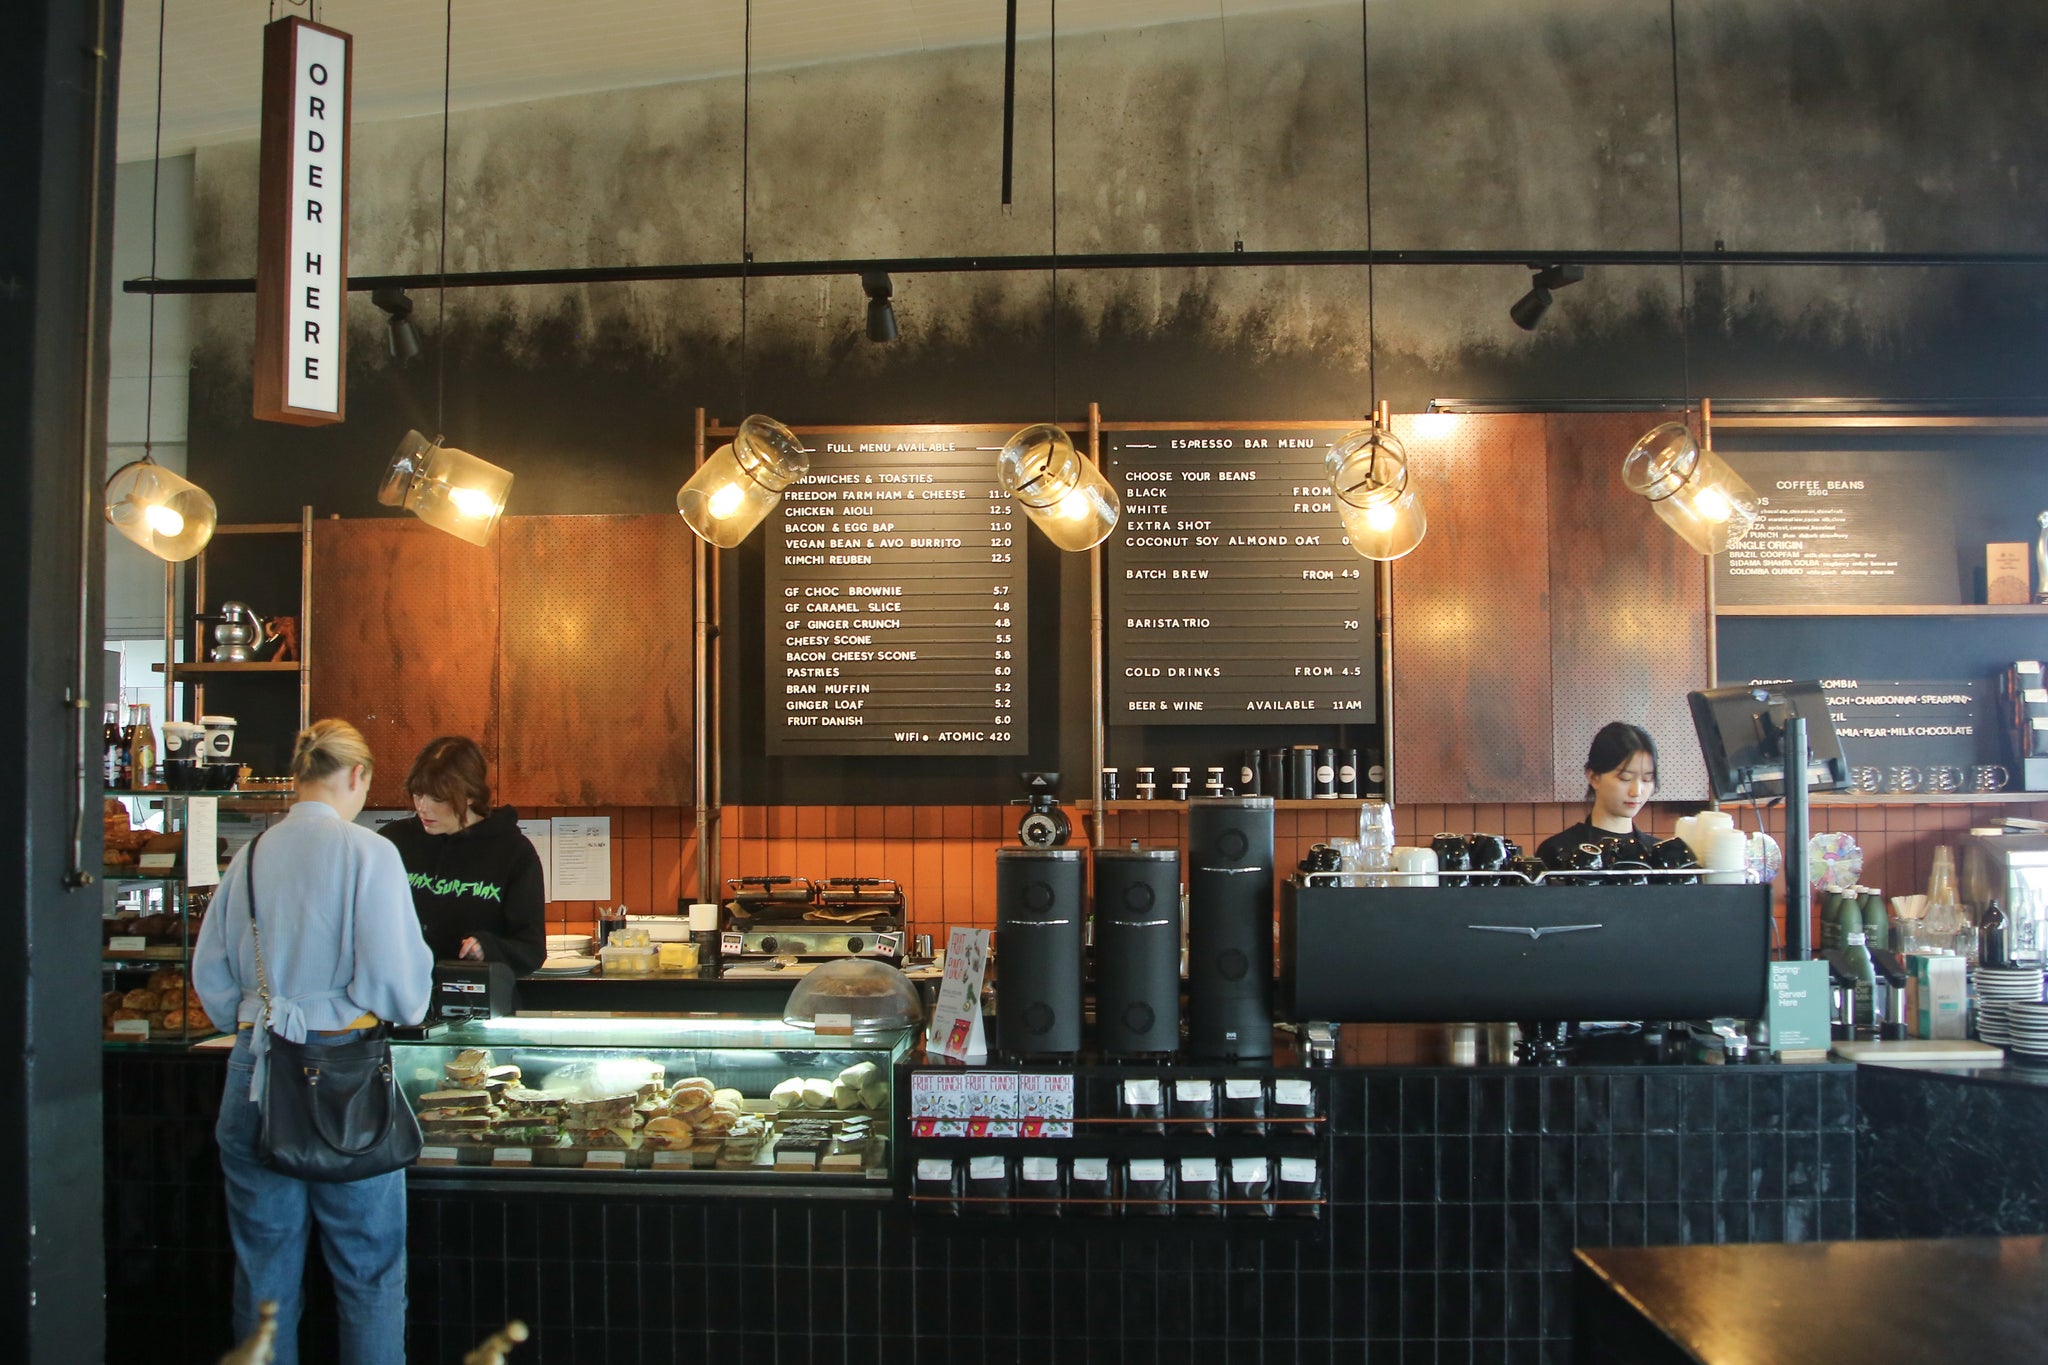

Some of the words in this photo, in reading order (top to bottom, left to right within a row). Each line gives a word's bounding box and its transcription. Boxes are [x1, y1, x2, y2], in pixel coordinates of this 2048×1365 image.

[307, 62, 329, 224] ORDER
[304, 251, 322, 381] HERE
[828, 444, 853, 452] FULL
[860, 444, 891, 452] MENU
[897, 443, 955, 451] AVAILABLE
[1172, 440, 1232, 448] ESPRESSO
[1245, 439, 1267, 448] BAR
[1279, 439, 1313, 447] MENU
[792, 473, 860, 484] NDWICHES
[865, 475, 872, 483] &
[879, 474, 933, 482] TOASTIES
[1126, 472, 1172, 480] CHOOSE
[1182, 472, 1210, 481] YOUR
[1219, 471, 1255, 480] BEANS
[1777, 481, 1819, 489] COFFEE
[1828, 481, 1864, 489] BEANS
[785, 492, 836, 500] FREEDOM
[877, 491, 901, 499] HAM
[907, 490, 914, 498] &
[922, 490, 965, 499] CHEESE
[1128, 488, 1166, 497] BLACK
[1294, 487, 1331, 495] FROM
[786, 507, 833, 516] CHICKEN
[843, 507, 872, 515] AIOLI
[991, 506, 1011, 514] 12.5
[1127, 505, 1167, 513] WHITE
[1295, 503, 1331, 512] FROM
[786, 524, 824, 532] BACON
[832, 524, 839, 532] &
[845, 523, 867, 532] EGG
[873, 523, 894, 532] BAP
[1128, 522, 1170, 530] EXTRA
[1178, 521, 1211, 530] SHOT
[786, 540, 824, 548] VEGAN
[830, 539, 860, 547] BEAN
[867, 539, 874, 547] &
[880, 539, 903, 547] AVO
[911, 539, 961, 547] BURRITO
[992, 538, 1011, 546] 12.0
[1126, 538, 1188, 546] COCONUT
[1196, 537, 1218, 545] SOY
[1229, 536, 1287, 545] ALMOND
[1296, 536, 1319, 545] OAT
[1767, 541, 1803, 550] ORIGIN
[785, 556, 824, 564] KIMCHI
[830, 556, 871, 564] REUBEN
[992, 554, 1010, 562] 12.5
[1127, 570, 1166, 578] BATCH
[1173, 570, 1208, 578] BREW
[1303, 571, 1333, 579] FROM
[1342, 570, 1359, 578] 4.9
[785, 588, 799, 596] GF
[805, 587, 839, 596] CHOC
[849, 587, 902, 595] BROWNIE
[994, 586, 1008, 594] 5.7
[785, 604, 799, 612] GF
[807, 604, 859, 612] CARAMEL
[869, 603, 901, 611] SLICE
[994, 603, 1009, 611] 4.8
[786, 621, 800, 629] GF
[808, 620, 849, 629] GINGER
[854, 620, 899, 628] CRUNCH
[995, 619, 1010, 627] 4.8
[1128, 619, 1179, 627] BARISTA
[1183, 619, 1209, 627] TRIO
[787, 636, 829, 646] CHEESY
[834, 636, 871, 644] SCONE
[997, 635, 1011, 643] 5.5
[787, 652, 825, 661] BACON
[832, 652, 874, 660] CHEESY
[878, 651, 916, 660] SCONE
[996, 651, 1010, 659] 5.8
[787, 668, 839, 677] PASTRIES
[995, 667, 1010, 675] 6.0
[1126, 668, 1160, 676] COLD
[1168, 668, 1220, 676] DRINKS
[1296, 667, 1332, 675] FROM
[1342, 667, 1360, 675] 4.5
[787, 685, 816, 693] BRAN
[826, 685, 869, 693] MUFFIN
[995, 683, 1010, 691] 5.2
[787, 701, 828, 709] GINGER
[835, 700, 863, 709] LOAF
[996, 699, 1010, 707] 5.2
[1129, 702, 1155, 710] BEER
[1161, 701, 1167, 709] &
[1174, 702, 1203, 710] WINE
[1247, 701, 1314, 710] AVAILABLE
[788, 717, 818, 725] FRUIT
[822, 717, 862, 725] DANISH
[995, 716, 1010, 724] 6.0
[1830, 713, 1847, 721] ZIL
[1890, 727, 1915, 735] MILK
[895, 733, 918, 741] WIFI
[939, 732, 983, 741] ATOMIC
[434, 879, 468, 896] SURF
[468, 881, 501, 902] WAX
[912, 1076, 932, 1091] FRUIT
[937, 1076, 962, 1091] PUNCH
[965, 1076, 985, 1091] FRUIT
[990, 1076, 1015, 1091] PUNCH
[1020, 1076, 1039, 1091] FRUIT
[1045, 1076, 1070, 1091] PUNCH
